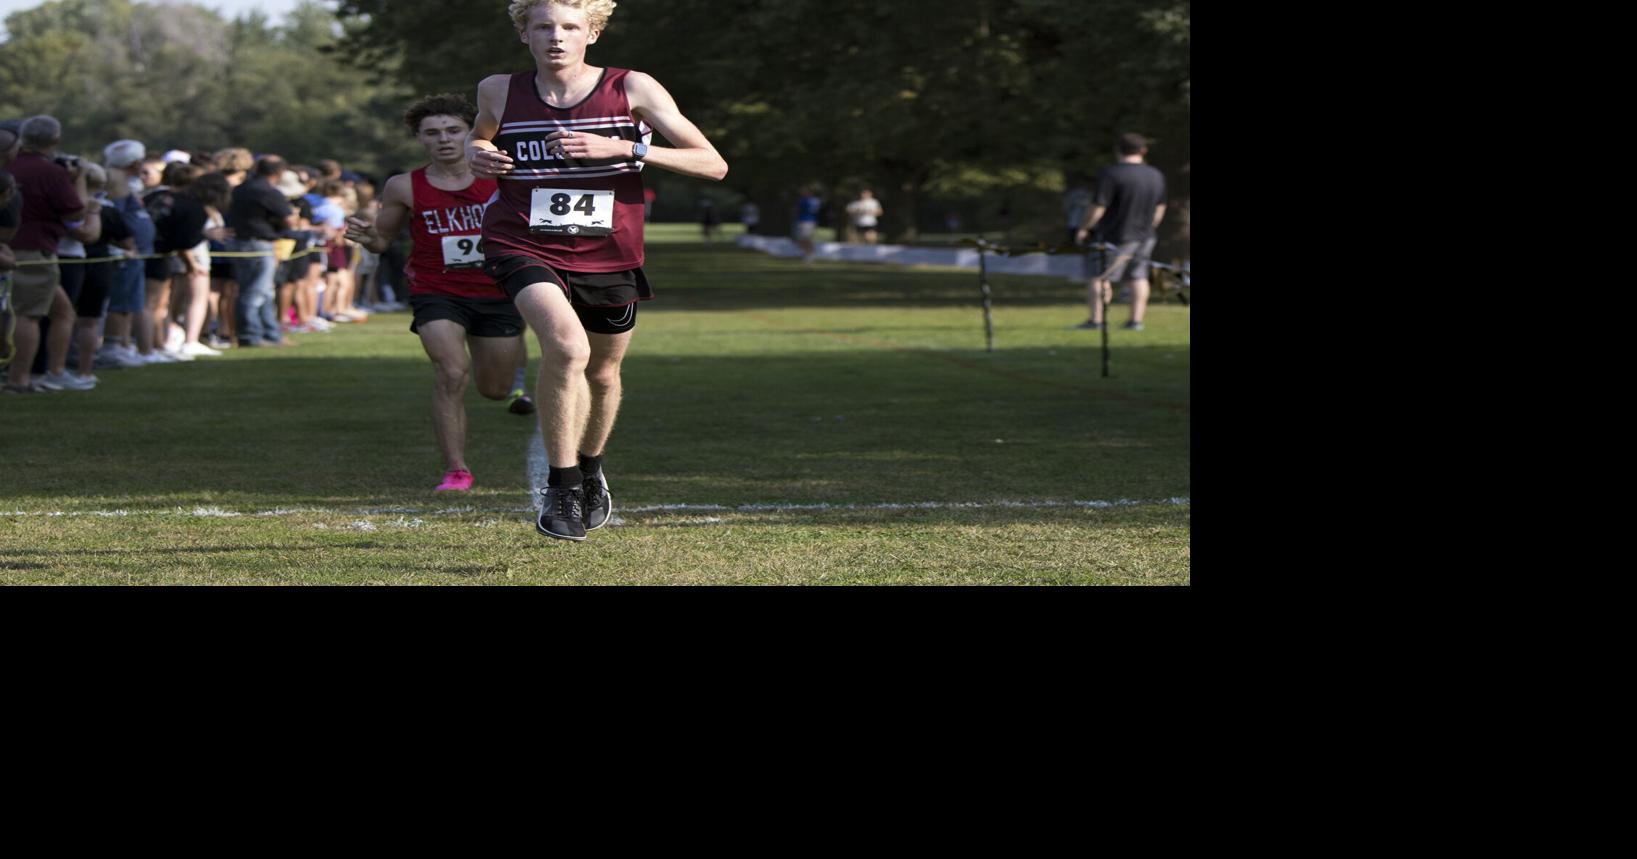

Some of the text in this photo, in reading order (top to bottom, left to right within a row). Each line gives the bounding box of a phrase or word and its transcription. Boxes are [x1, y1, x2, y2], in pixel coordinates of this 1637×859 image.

[516, 139, 564, 161] COL
[550, 193, 596, 216] 84
[422, 204, 486, 234] ELKHO
